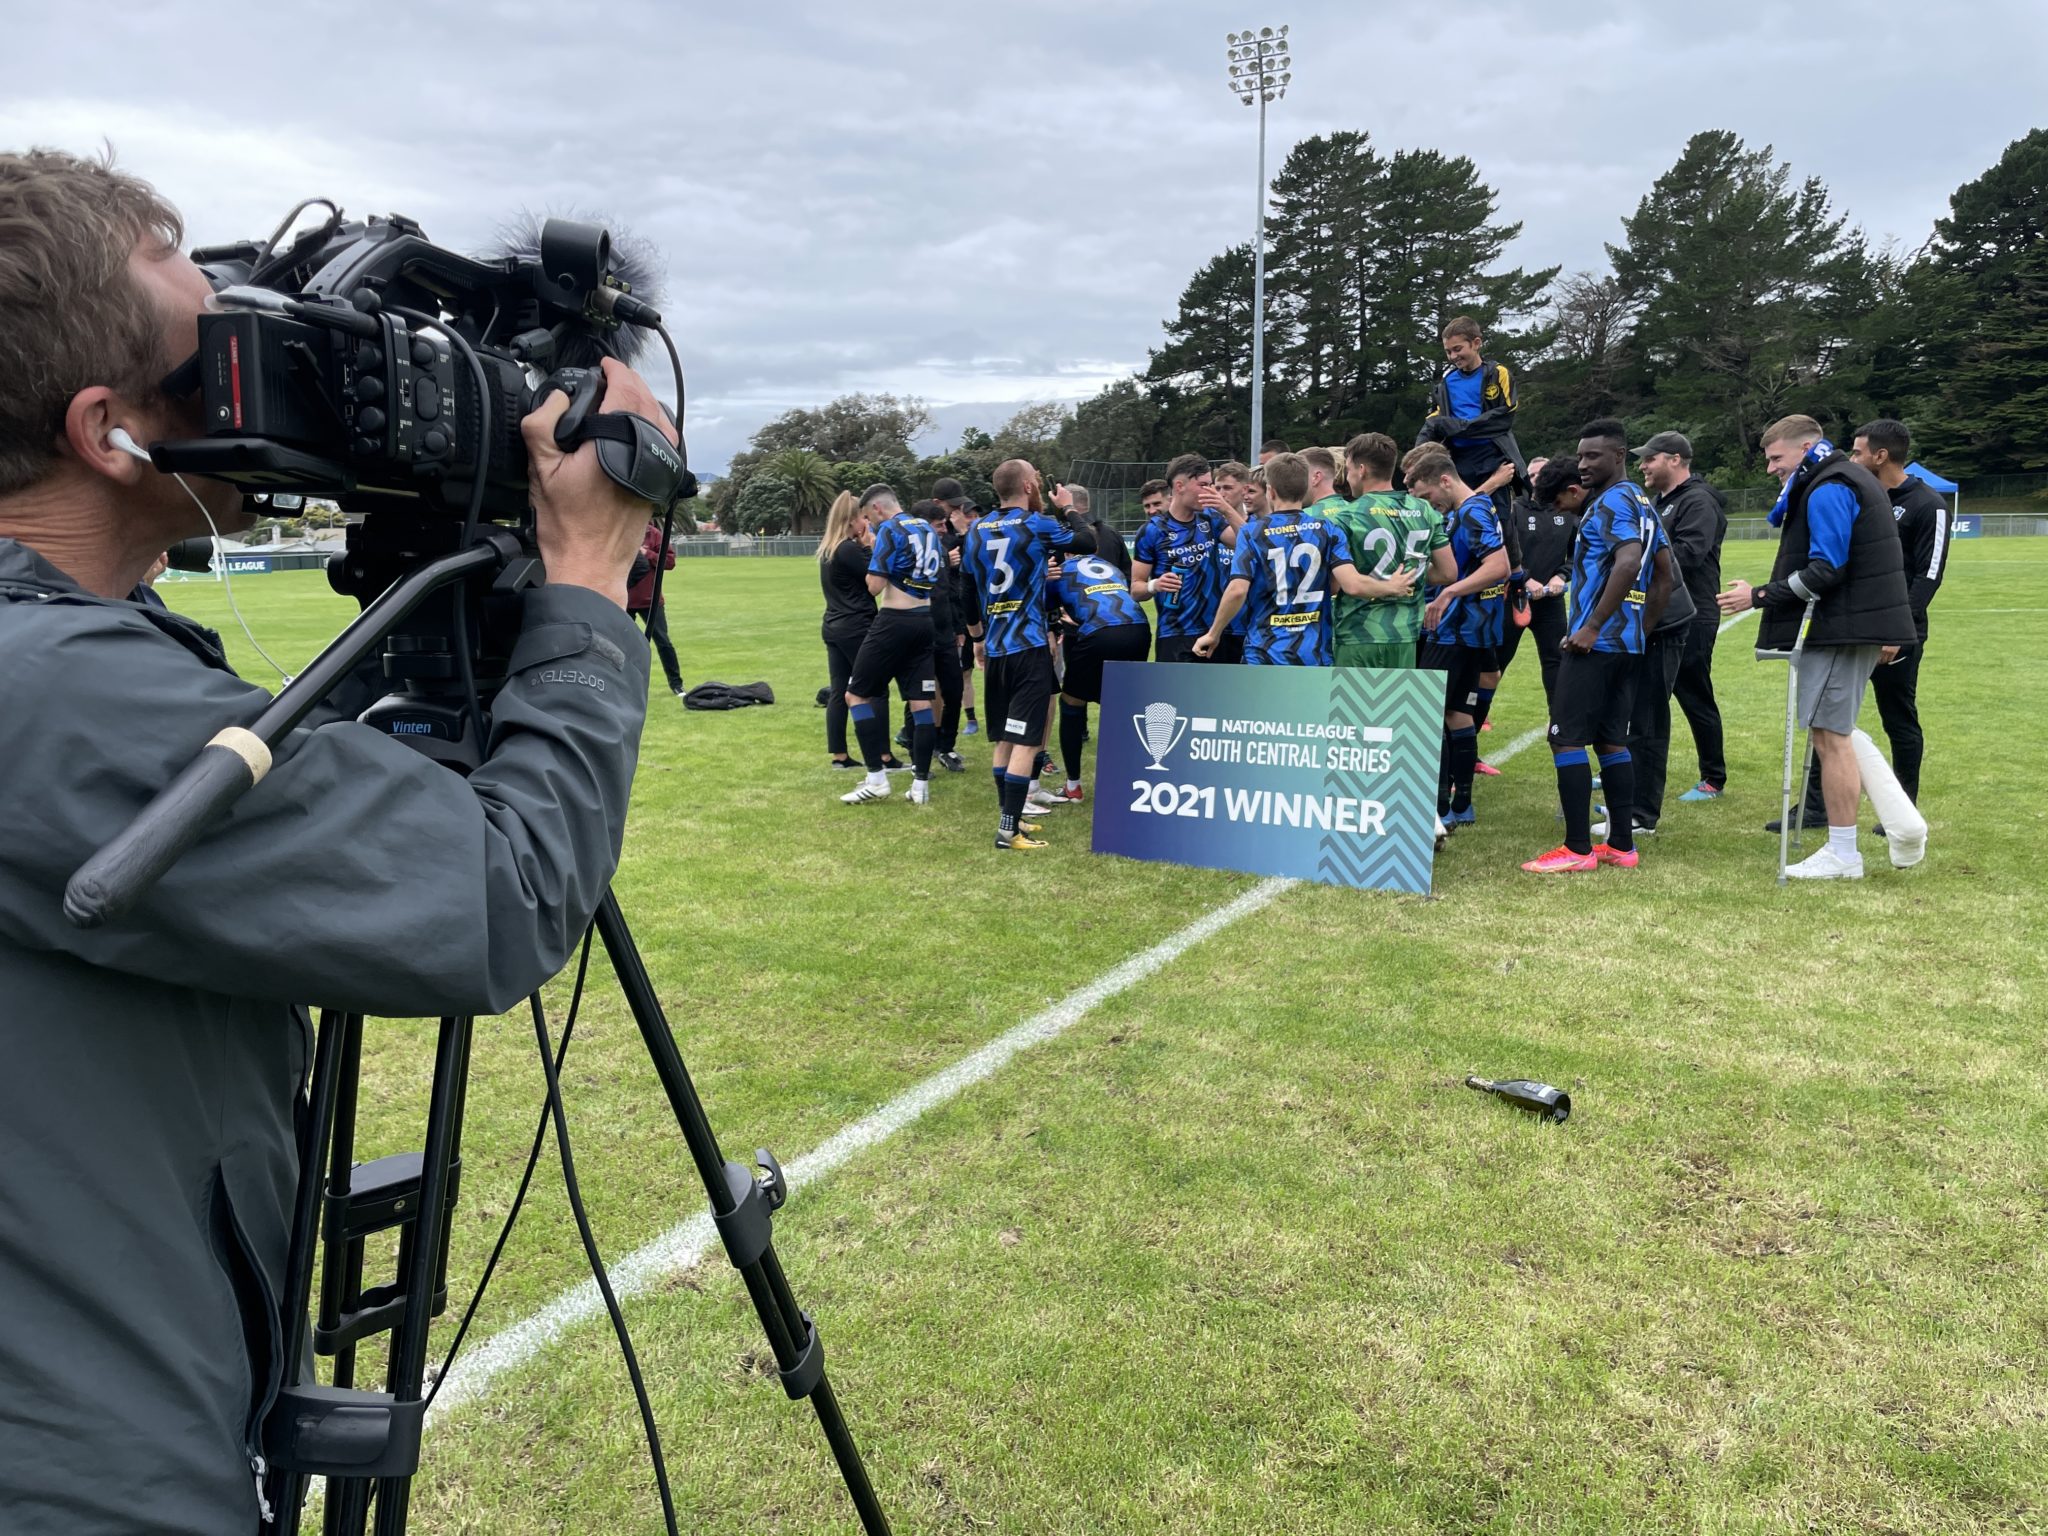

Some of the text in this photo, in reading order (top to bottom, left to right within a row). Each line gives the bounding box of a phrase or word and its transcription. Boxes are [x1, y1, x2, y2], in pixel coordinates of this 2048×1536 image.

[651, 443, 679, 473] SONY
[1264, 522, 1322, 536] STONEWOOD
[908, 532, 939, 578] 16
[1167, 538, 1215, 558] MONSOON
[1181, 550, 1210, 565] POON
[1364, 528, 1430, 582] 25
[228, 561, 266, 571] LEAGUE
[986, 537, 1014, 595] 3
[1077, 557, 1114, 580] 6
[1267, 543, 1325, 606] 12
[392, 720, 432, 733] Vinten
[1222, 719, 1357, 740] NATIONAL LEAGUE
[1190, 737, 1391, 773] SOUTH CENTRAL SERIES
[1130, 780, 1386, 836] 2021 WINNER
